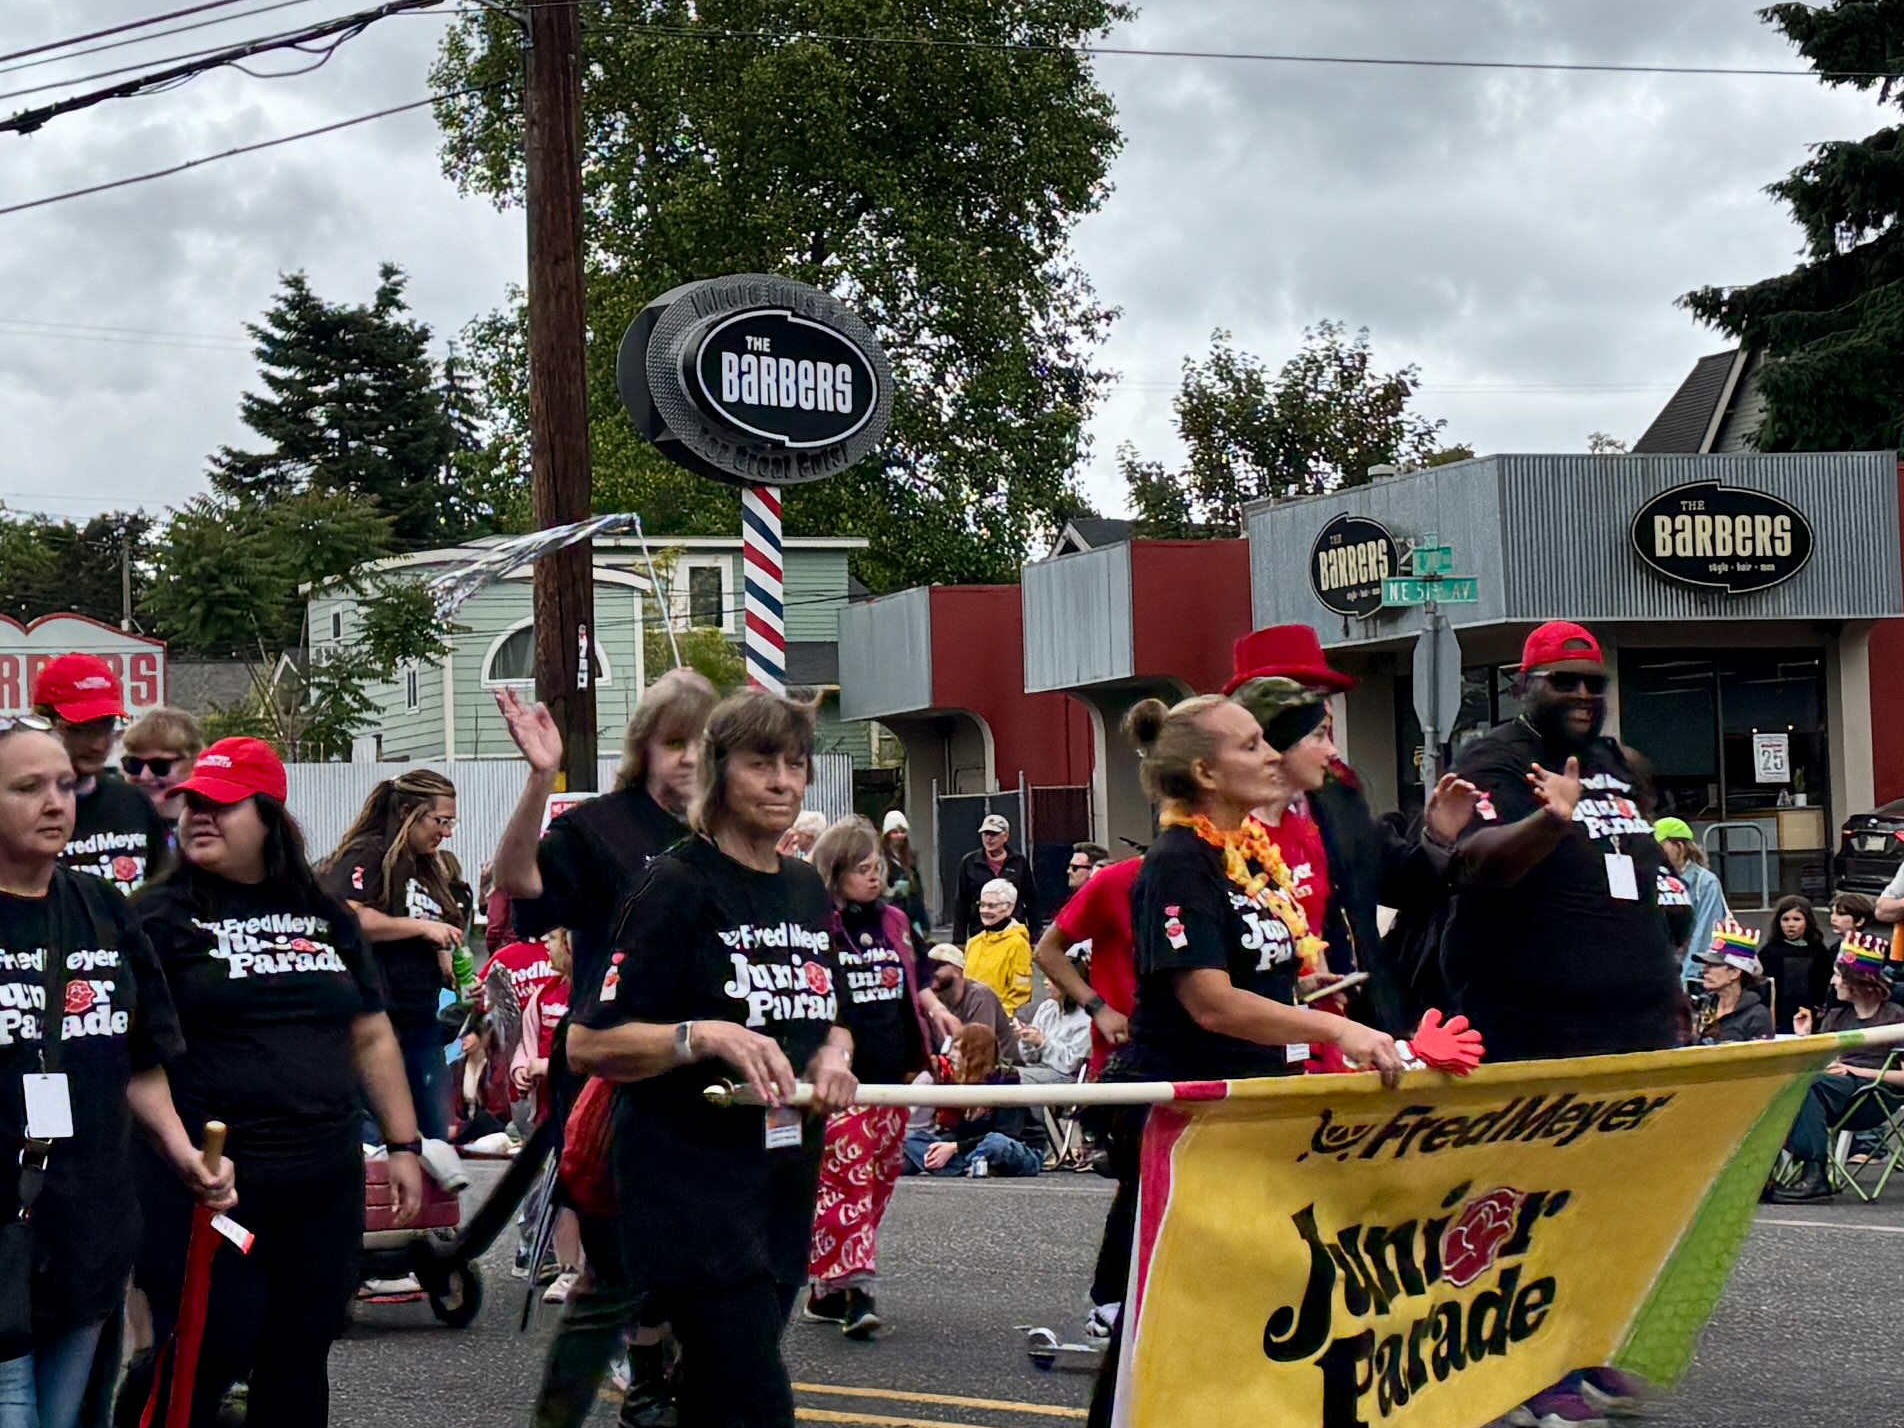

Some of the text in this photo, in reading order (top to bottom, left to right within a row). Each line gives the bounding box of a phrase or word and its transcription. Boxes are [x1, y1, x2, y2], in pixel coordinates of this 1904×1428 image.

[746, 336, 770, 352] THE
[1681, 501, 1705, 511] THE
[1389, 582, 1410, 601] NE
[1452, 582, 1472, 600] AV
[1762, 749, 1783, 770] 25
[740, 922, 830, 955] FredMeye
